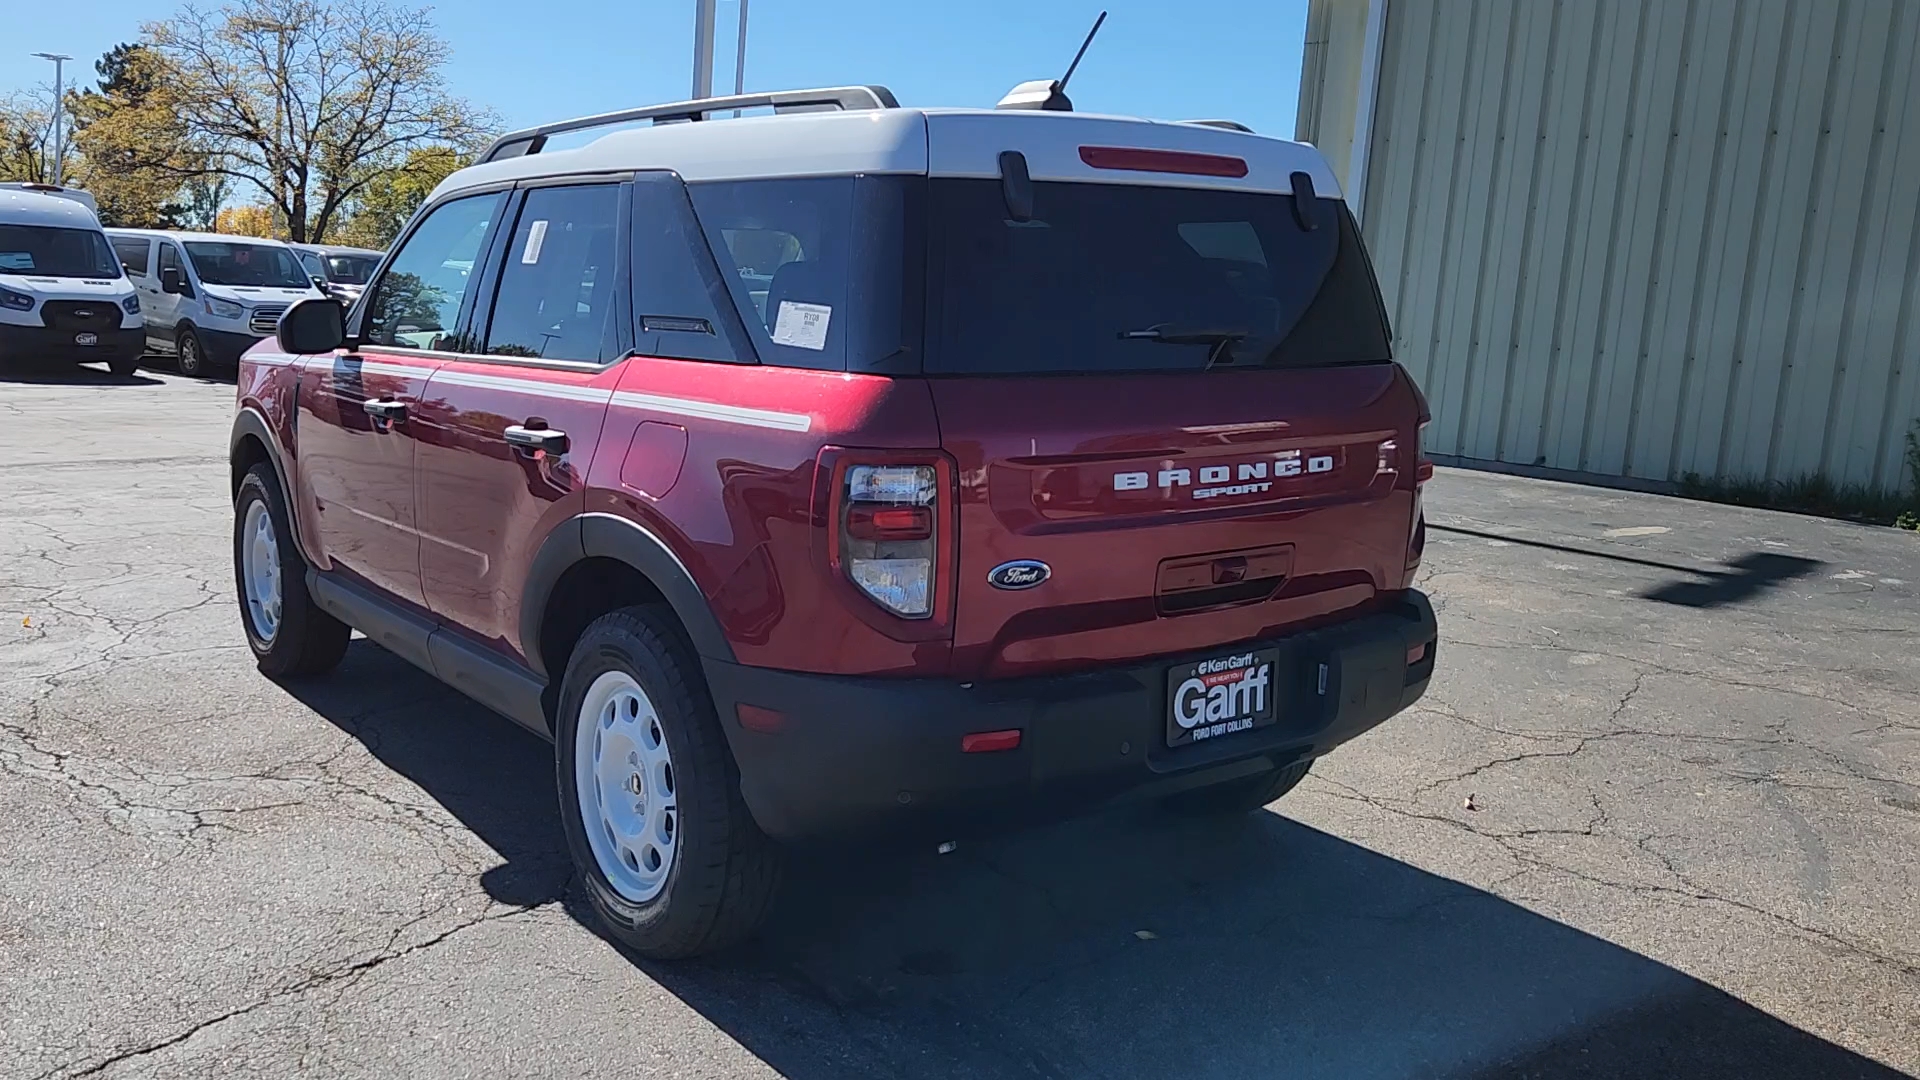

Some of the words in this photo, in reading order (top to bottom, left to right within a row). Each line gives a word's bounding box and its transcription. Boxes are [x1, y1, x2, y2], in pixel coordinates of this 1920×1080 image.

[1113, 455, 1333, 491] BRONCO
[1192, 481, 1273, 499] SPORT
[1004, 567, 1038, 583] Ford
[1207, 659, 1228, 673] Ken
[1228, 652, 1253, 669] Garff
[1174, 664, 1269, 729] Garff
[1193, 727, 1210, 741] FORD
[1210, 723, 1226, 737] FORT
[1227, 717, 1253, 733] COLLINS
